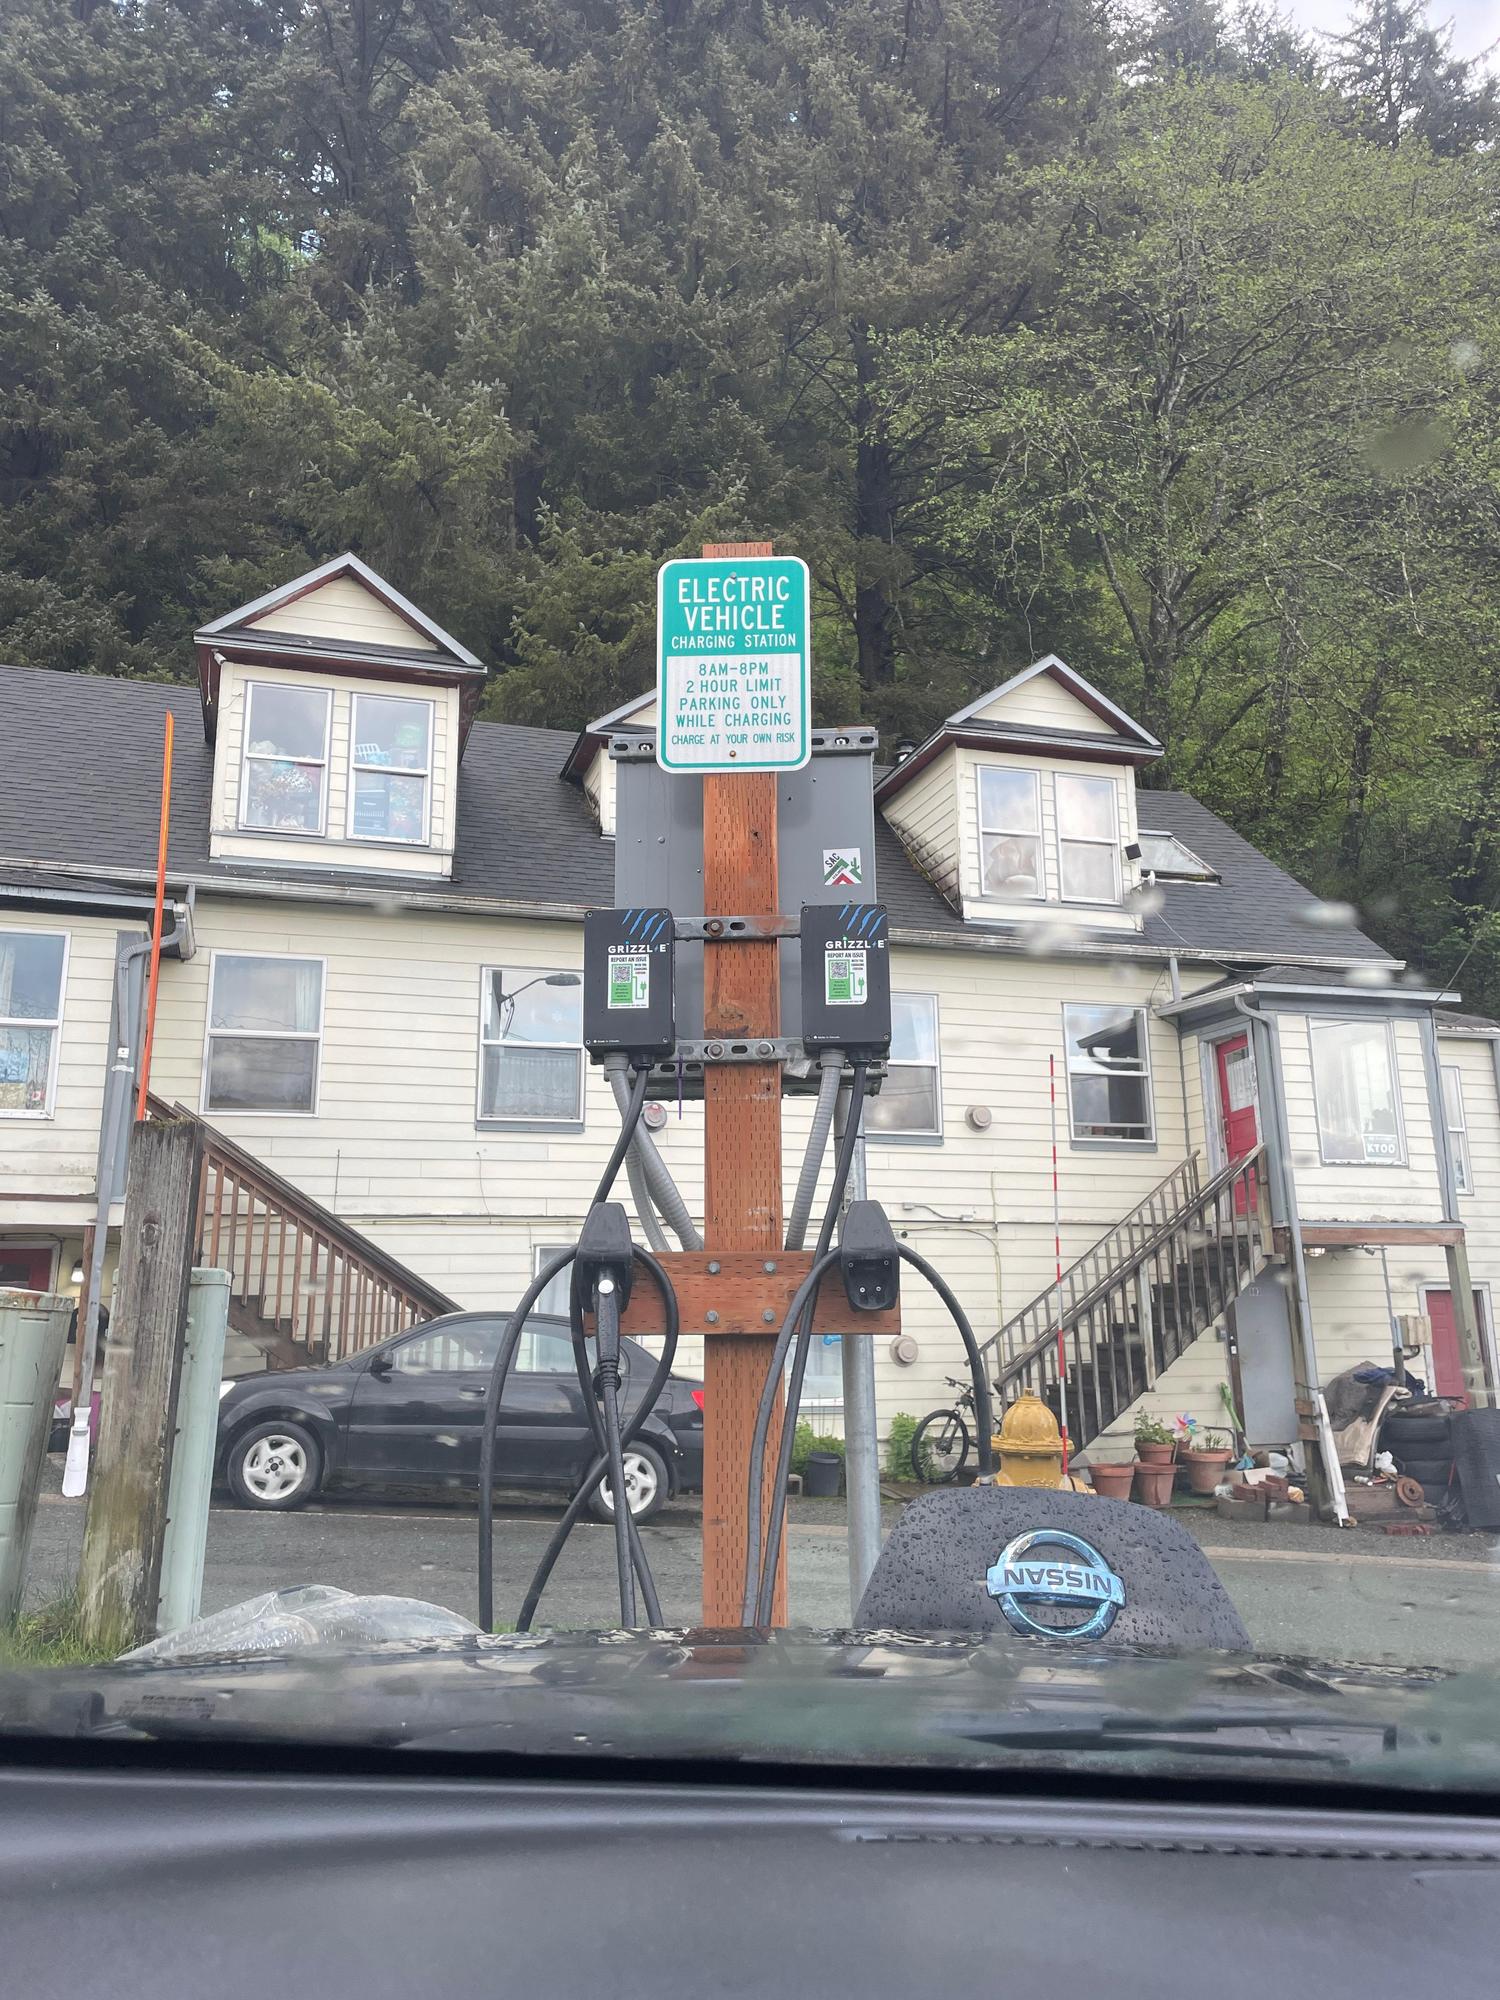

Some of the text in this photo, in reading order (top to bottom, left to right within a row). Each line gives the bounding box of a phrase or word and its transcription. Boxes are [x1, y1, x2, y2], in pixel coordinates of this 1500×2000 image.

[678, 576, 790, 603] ELECTRIC
[684, 604, 785, 631] VEHICLE
[671, 633, 796, 649] CHARGING STATION
[698, 662, 769, 676] 8AM-8PM
[686, 678, 782, 693] 2 HOUR LIMIT
[679, 695, 787, 711] PARKING ONLY
[676, 712, 791, 728] WHILE CHARGING
[671, 732, 795, 745] CHARGE AT YOUR OWN RISK
[825, 852, 840, 868] SAC
[1367, 1143, 1395, 1153] KTOO
[1004, 1567, 1112, 1598] NISSAN
